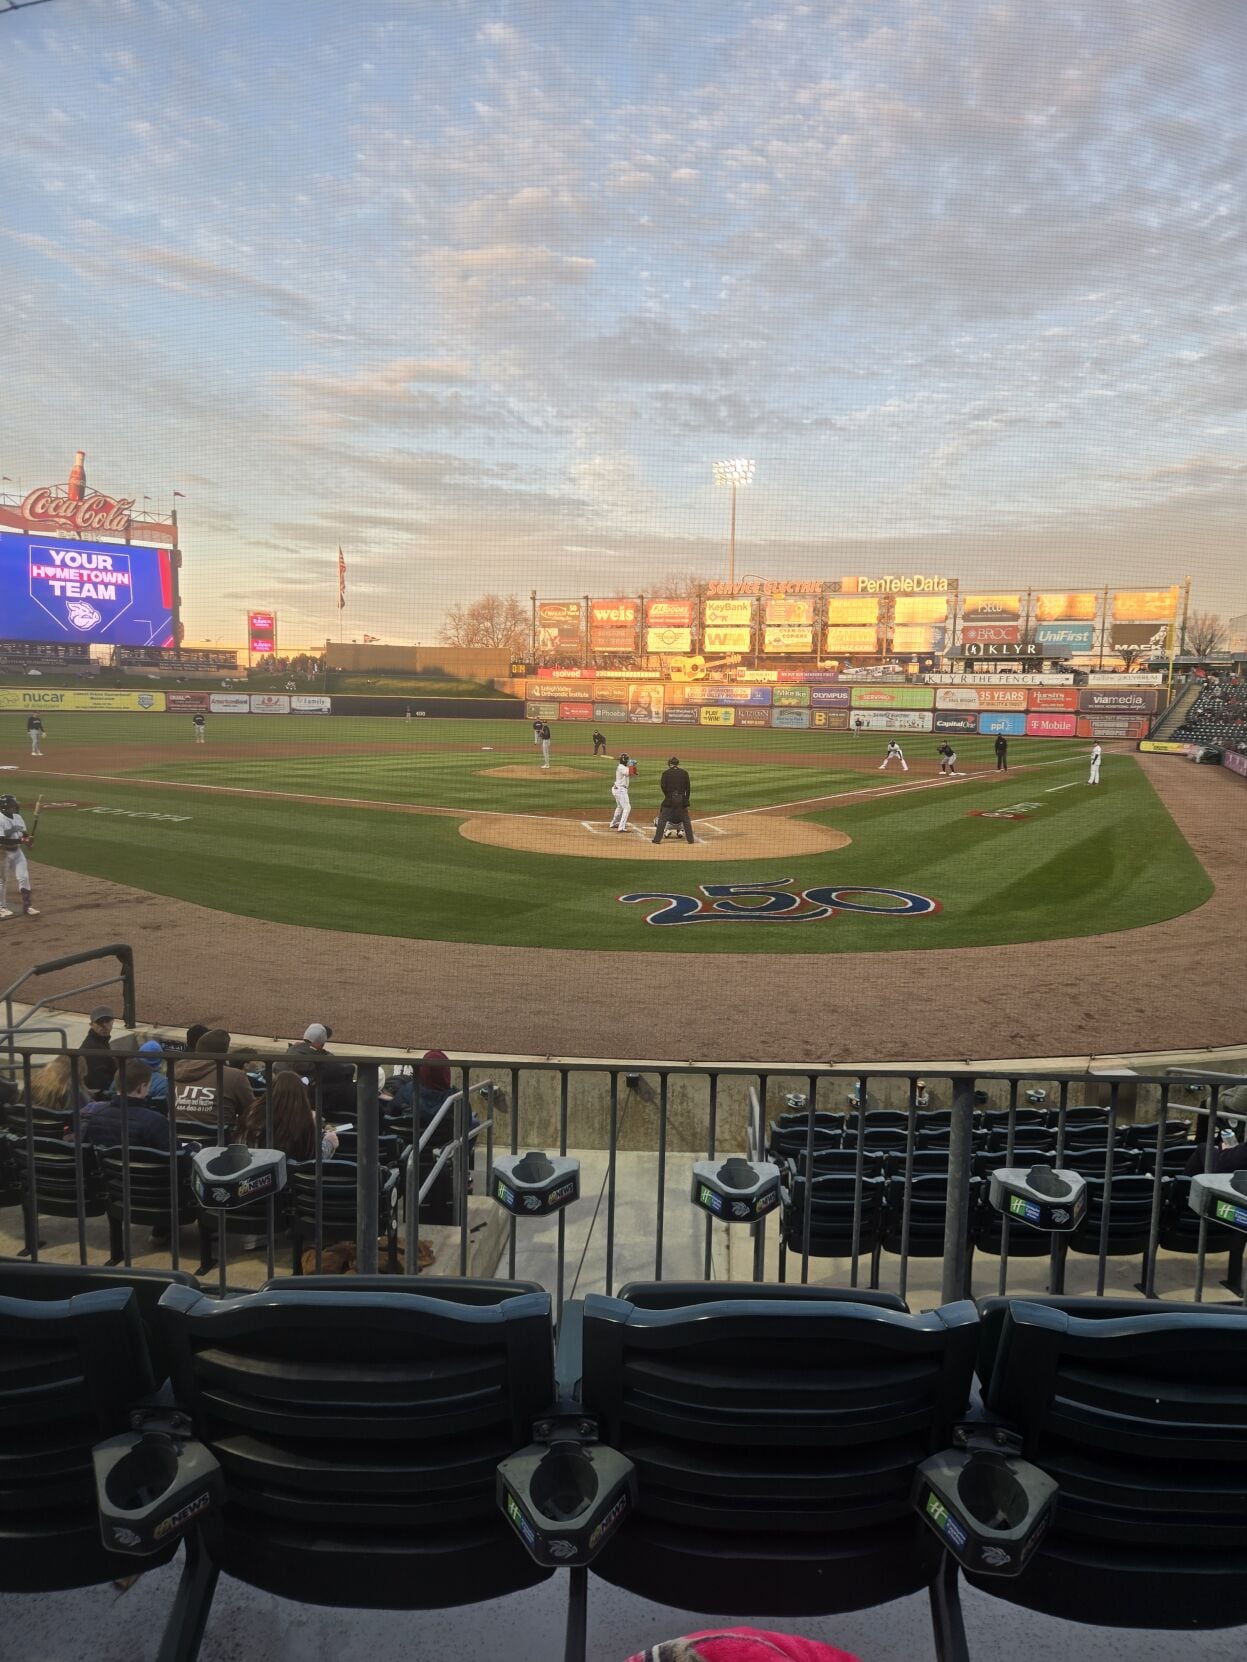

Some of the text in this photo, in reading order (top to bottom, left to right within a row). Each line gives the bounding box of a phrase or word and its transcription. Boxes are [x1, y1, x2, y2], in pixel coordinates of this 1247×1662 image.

[22, 487, 136, 531] Coca-Cola
[49, 550, 113, 570] YOUR
[49, 580, 116, 600] TEAM
[858, 575, 948, 592] PenTeleData
[594, 606, 634, 620] weis
[708, 603, 748, 612] KeyBank
[1039, 631, 1089, 642] UniFirst
[23, 692, 65, 702] nucar
[980, 691, 1024, 700] 35 YEARS
[1093, 695, 1142, 703] viamedia
[602, 710, 625, 718] Phoebe
[815, 712, 826, 726] B
[991, 722, 1005, 731] ppl
[1041, 720, 1072, 730] Mobile
[617, 877, 942, 926] 250
[179, 1085, 216, 1100] JTS
[170, 1491, 210, 1529] NEWS
